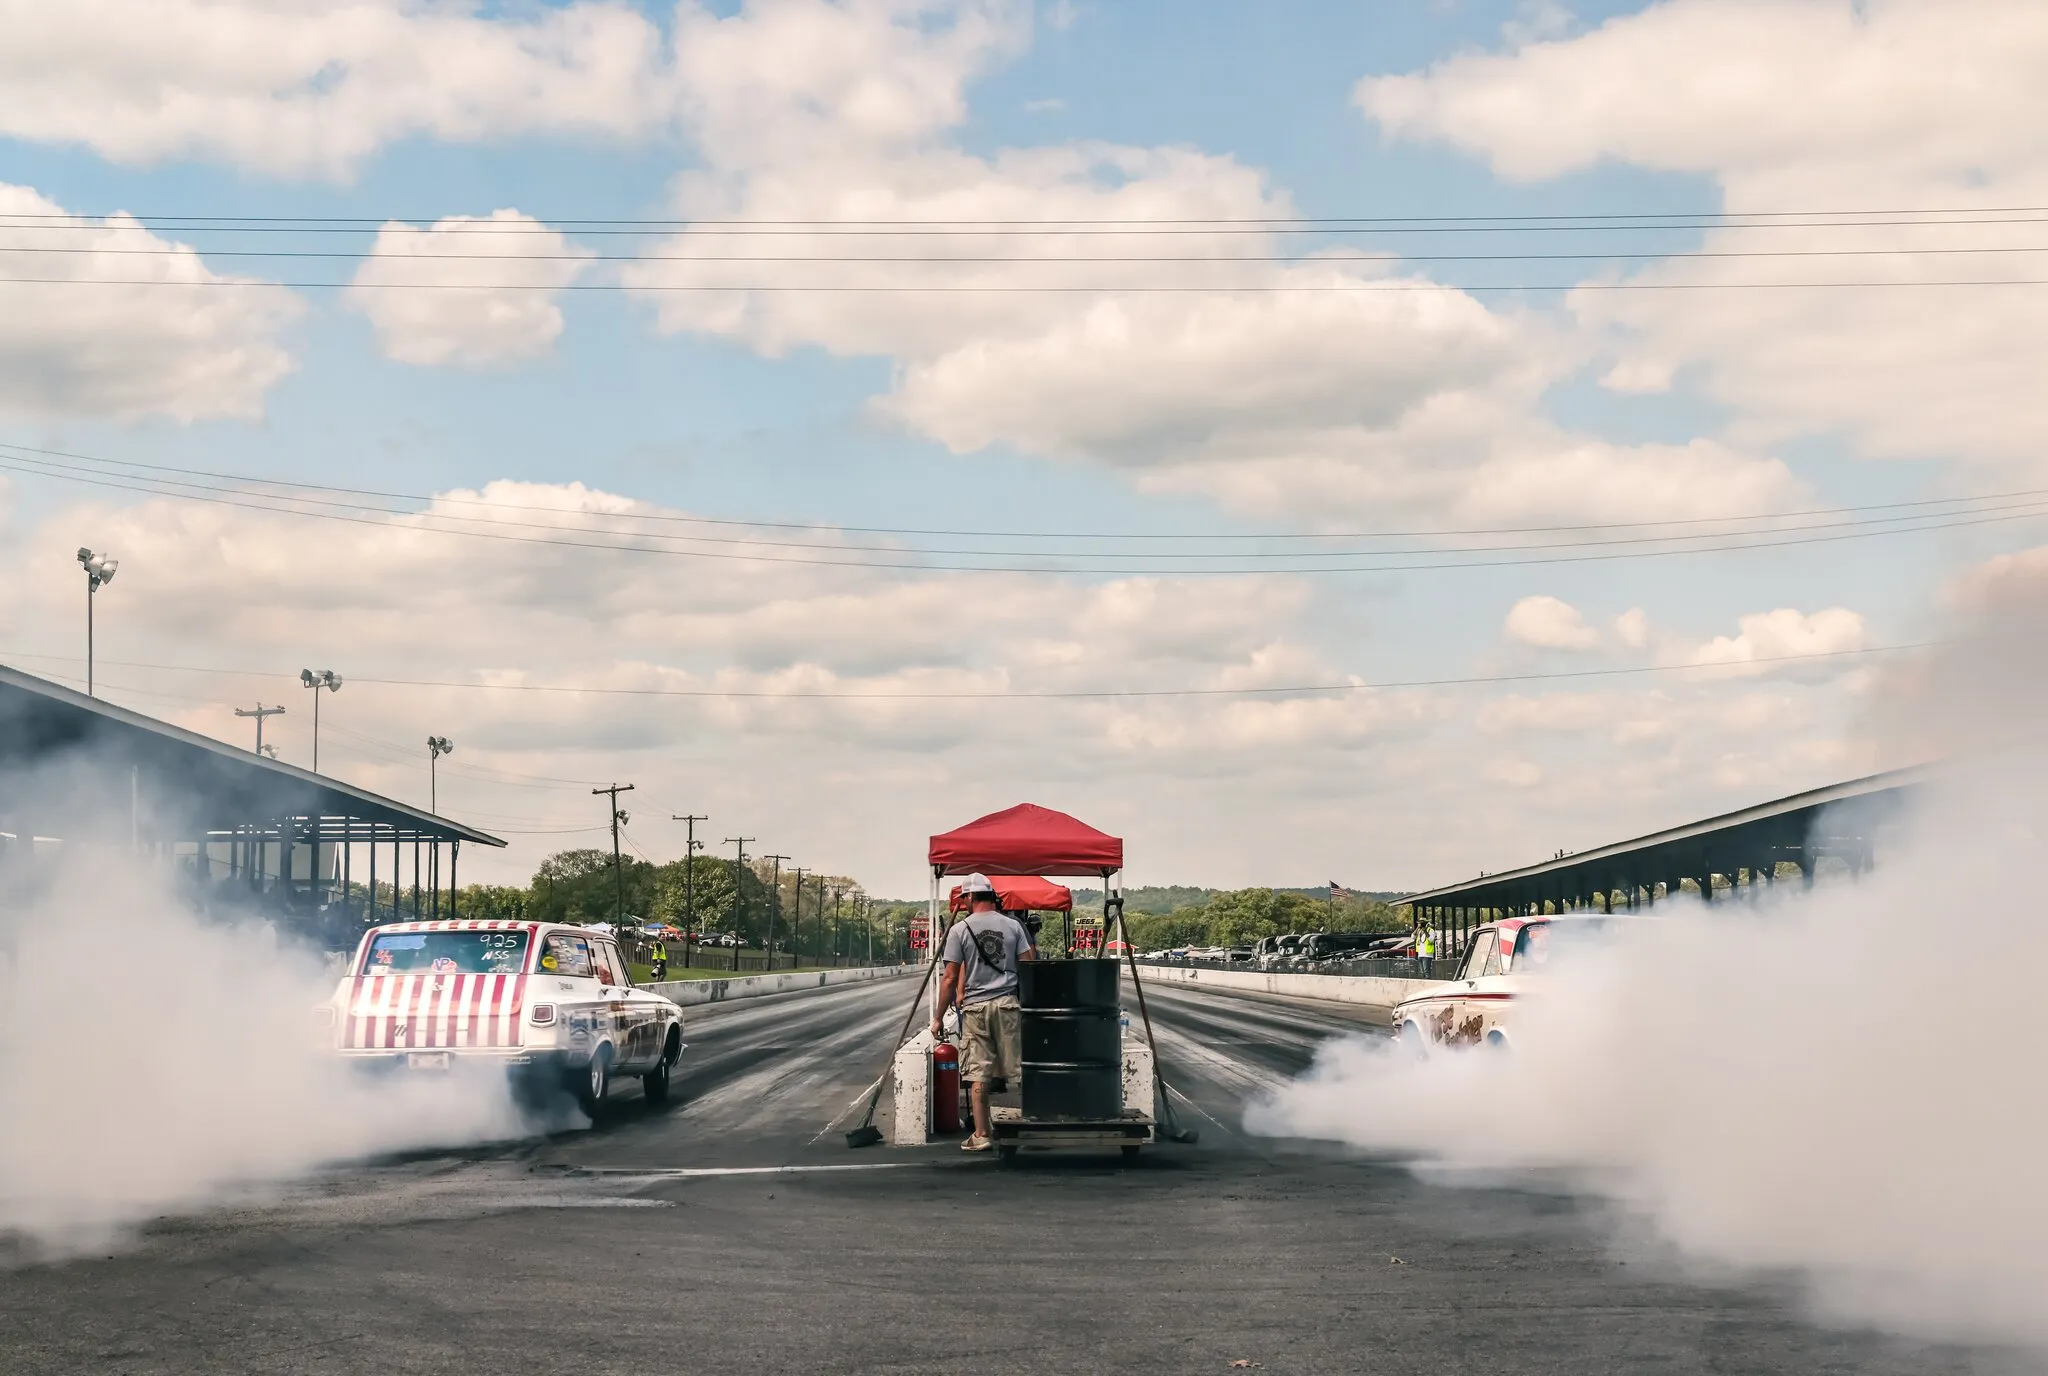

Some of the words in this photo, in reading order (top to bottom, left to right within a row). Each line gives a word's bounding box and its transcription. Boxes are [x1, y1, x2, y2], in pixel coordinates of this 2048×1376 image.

[479, 934, 518, 948] 9.25
[480, 950, 510, 960] NSS
[434, 957, 451, 971] VP
